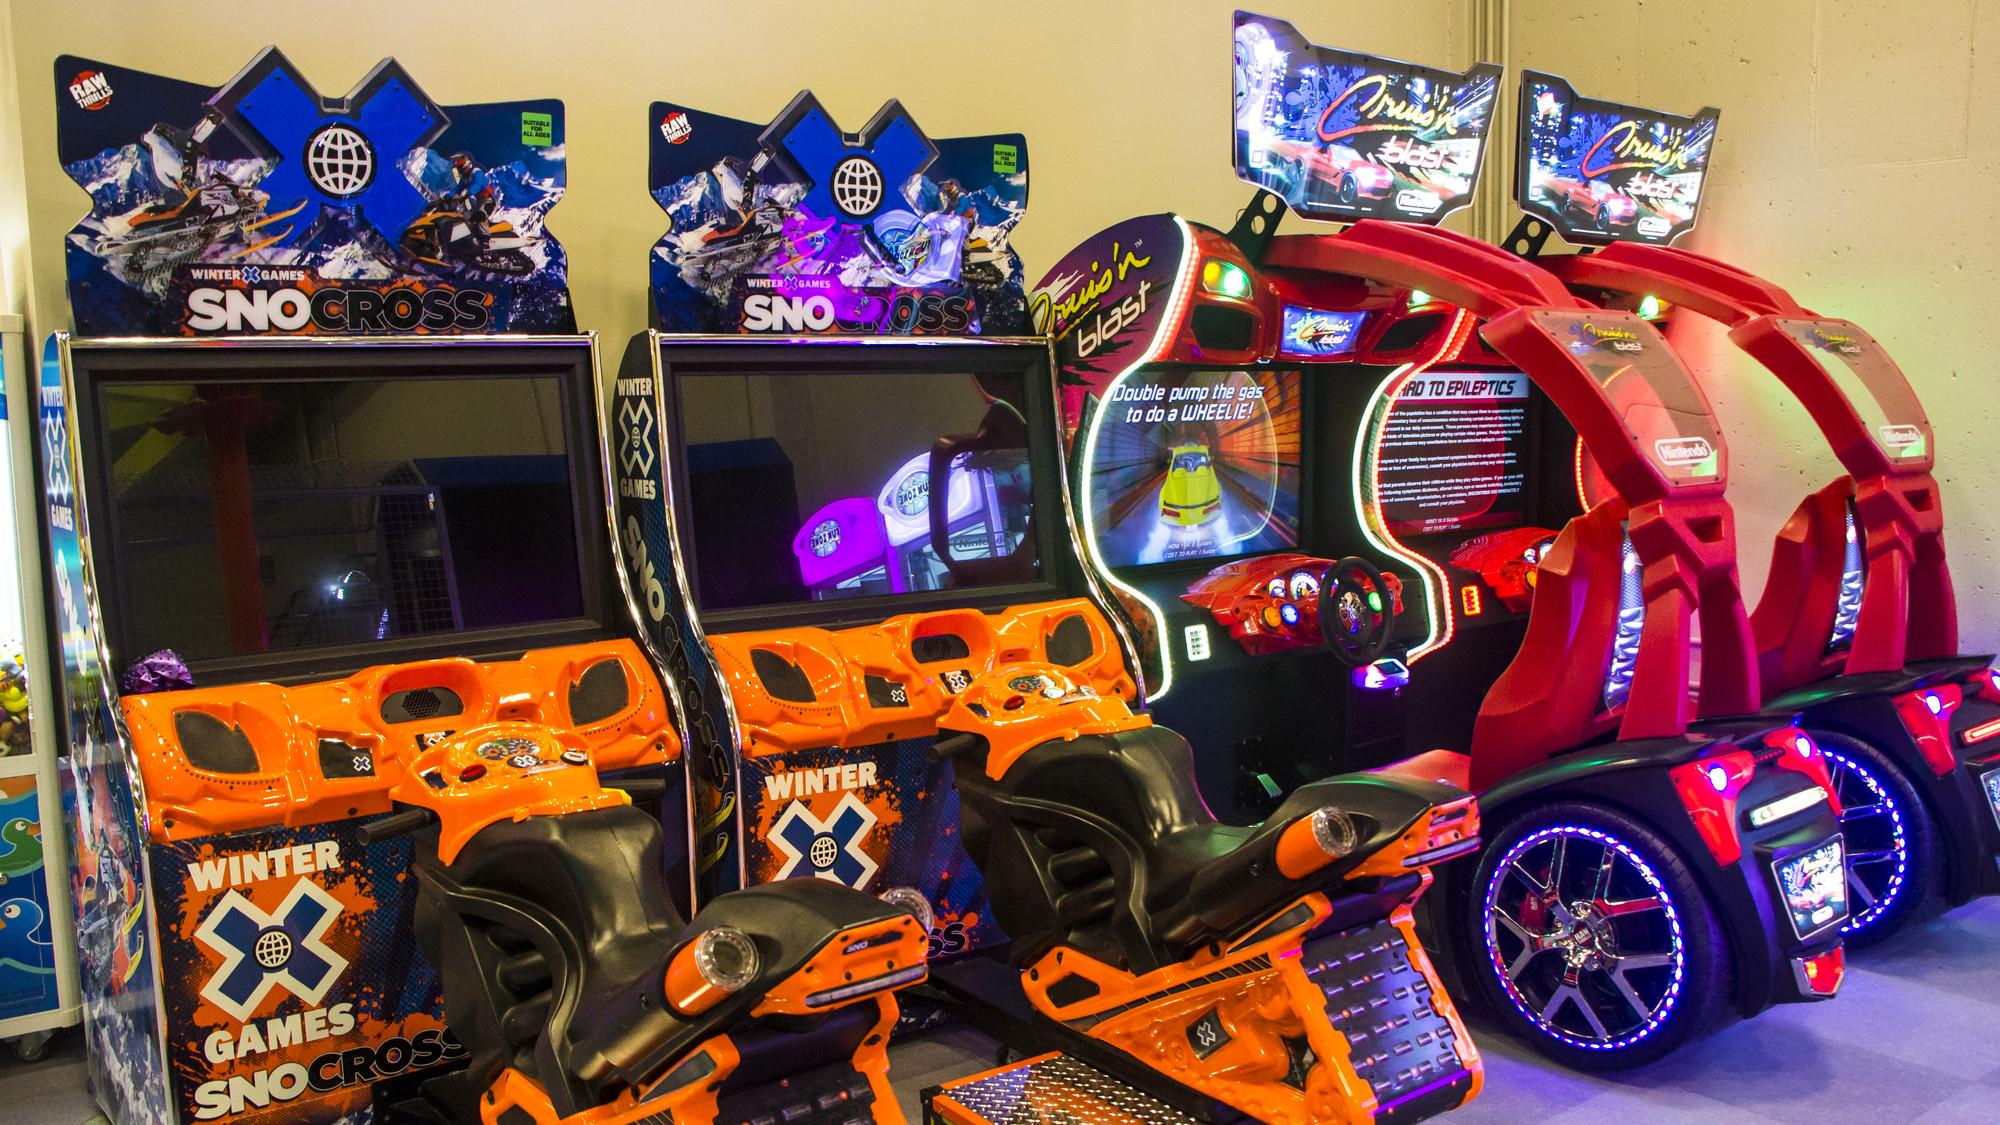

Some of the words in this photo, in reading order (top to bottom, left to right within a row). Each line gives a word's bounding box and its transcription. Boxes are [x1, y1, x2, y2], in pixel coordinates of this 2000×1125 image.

[69, 72, 108, 101] RAW
[77, 86, 113, 109] THRILLS
[1317, 75, 1457, 142] Cruis'n
[660, 113, 688, 137] RAW
[1376, 135, 1450, 170] blast
[1625, 171, 1678, 199] blast
[190, 269, 241, 280] WINTER
[260, 270, 305, 280] GAMES
[747, 278, 783, 289] WINTER
[798, 278, 831, 289] GAMES
[187, 287, 488, 331] SNOCROSS
[743, 295, 969, 332] SNOCROSS
[1078, 280, 1151, 358] blast
[42, 386, 64, 408] WINTER
[617, 377, 652, 397] WINTER
[1112, 384, 1166, 402] Double
[1168, 387, 1209, 402] pump
[1212, 383, 1235, 400] the
[1238, 386, 1265, 401] gas
[1429, 381, 1445, 397] TO
[1446, 380, 1517, 396] EPILEPTICS
[1126, 406, 1143, 424] to
[1145, 405, 1165, 423] do
[1167, 408, 1178, 422] a
[1181, 401, 1255, 421] WHEELIE!
[1660, 443, 1709, 459] Nintendo
[620, 478, 656, 500] GAMES
[51, 503, 73, 532] GAMES
[765, 761, 877, 801] WINTER
[187, 840, 341, 892] WINTER
[204, 1002, 355, 1064] GAMES
